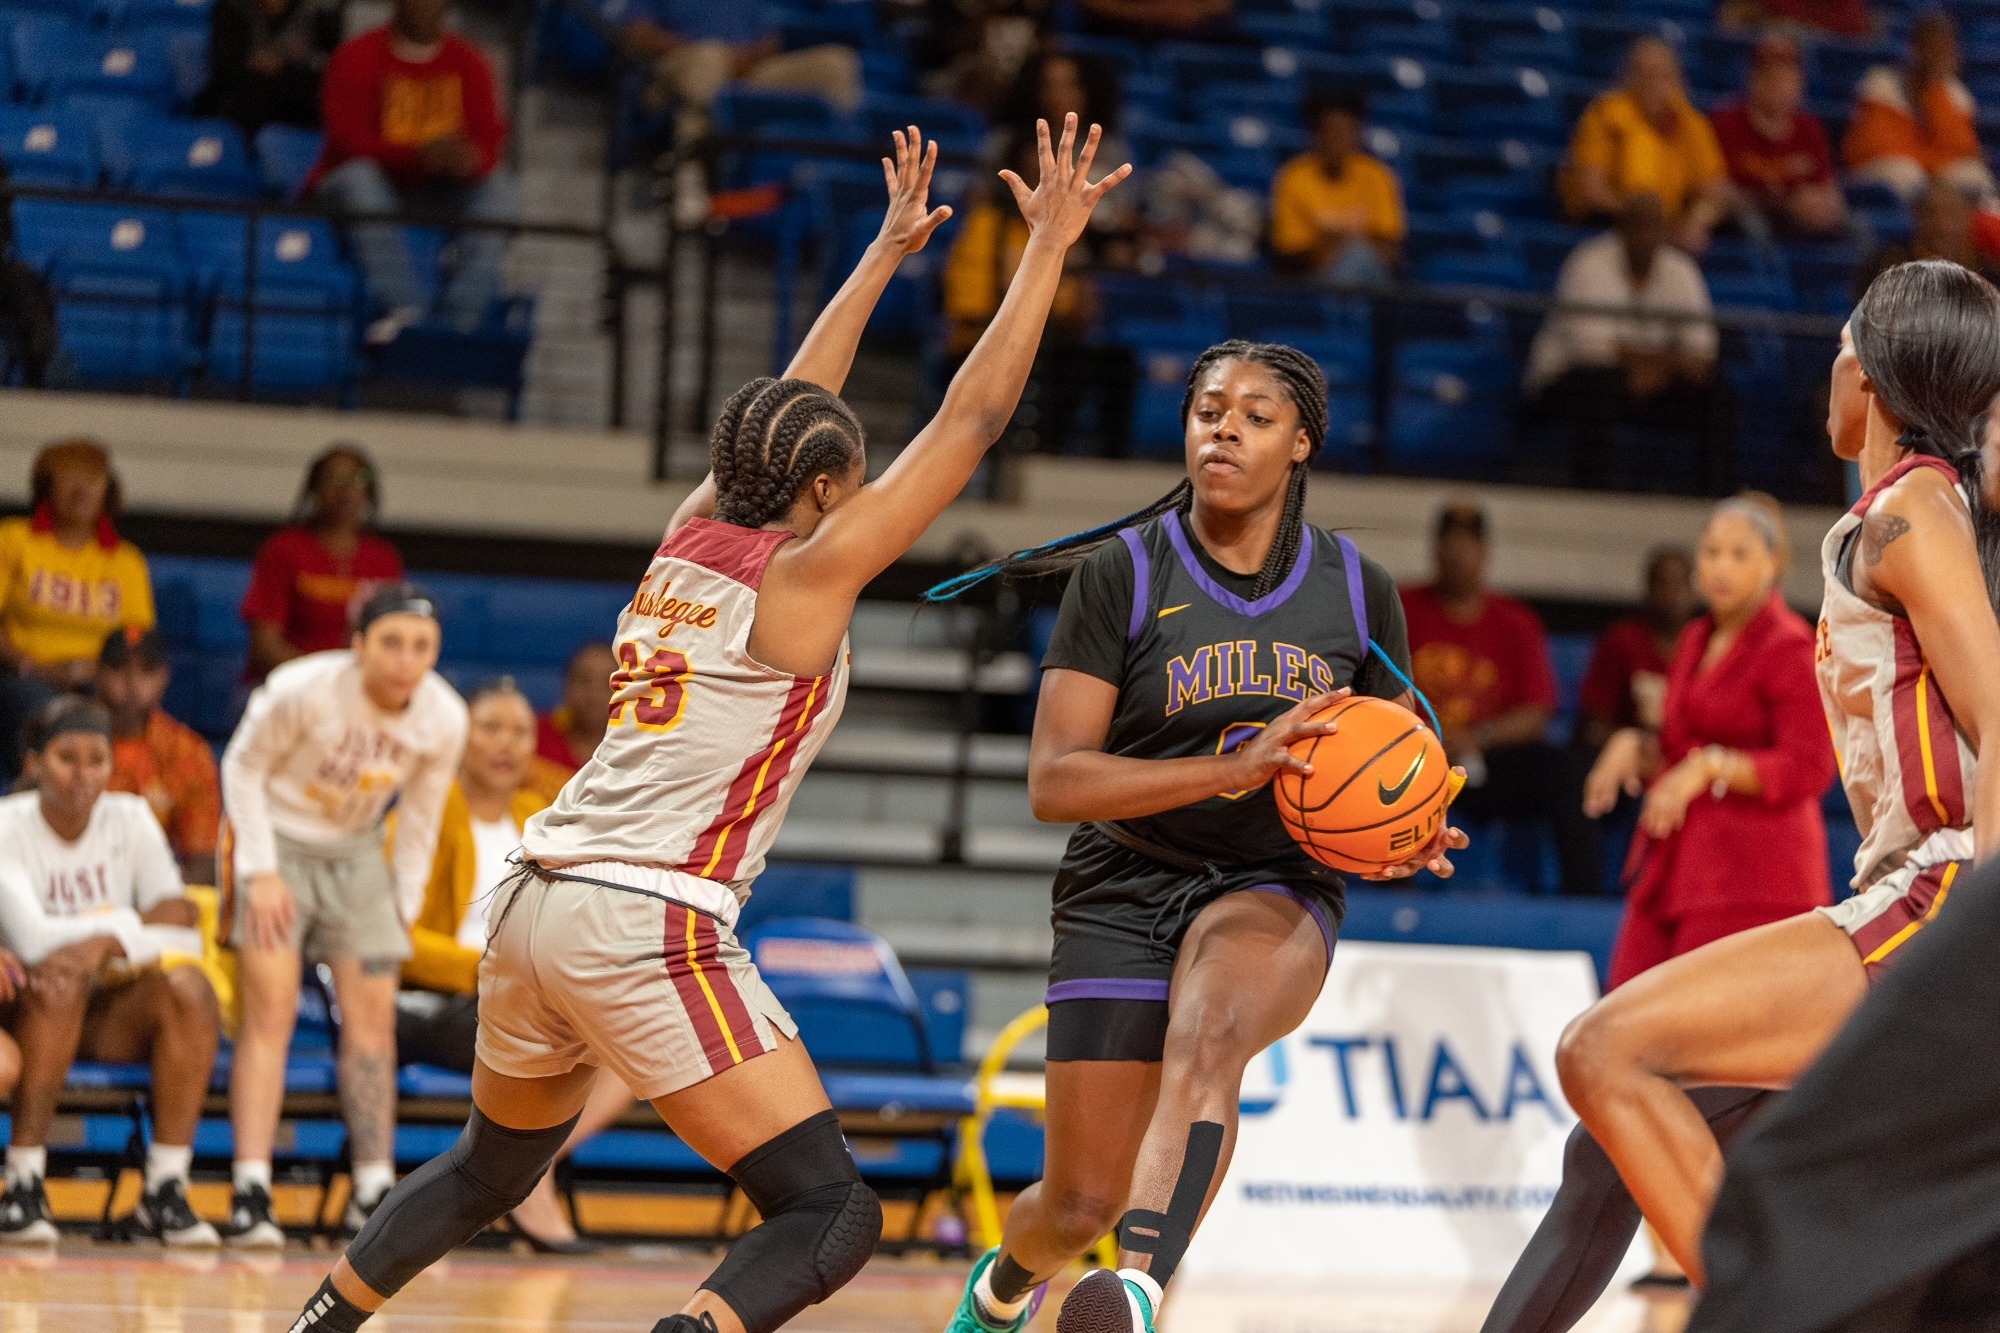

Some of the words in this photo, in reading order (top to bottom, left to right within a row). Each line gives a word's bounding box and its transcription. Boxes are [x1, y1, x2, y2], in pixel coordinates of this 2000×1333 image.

[628, 574, 719, 639] Tuskegee
[1166, 640, 1334, 717] MILES
[1307, 1033, 1569, 1126] TIAA
